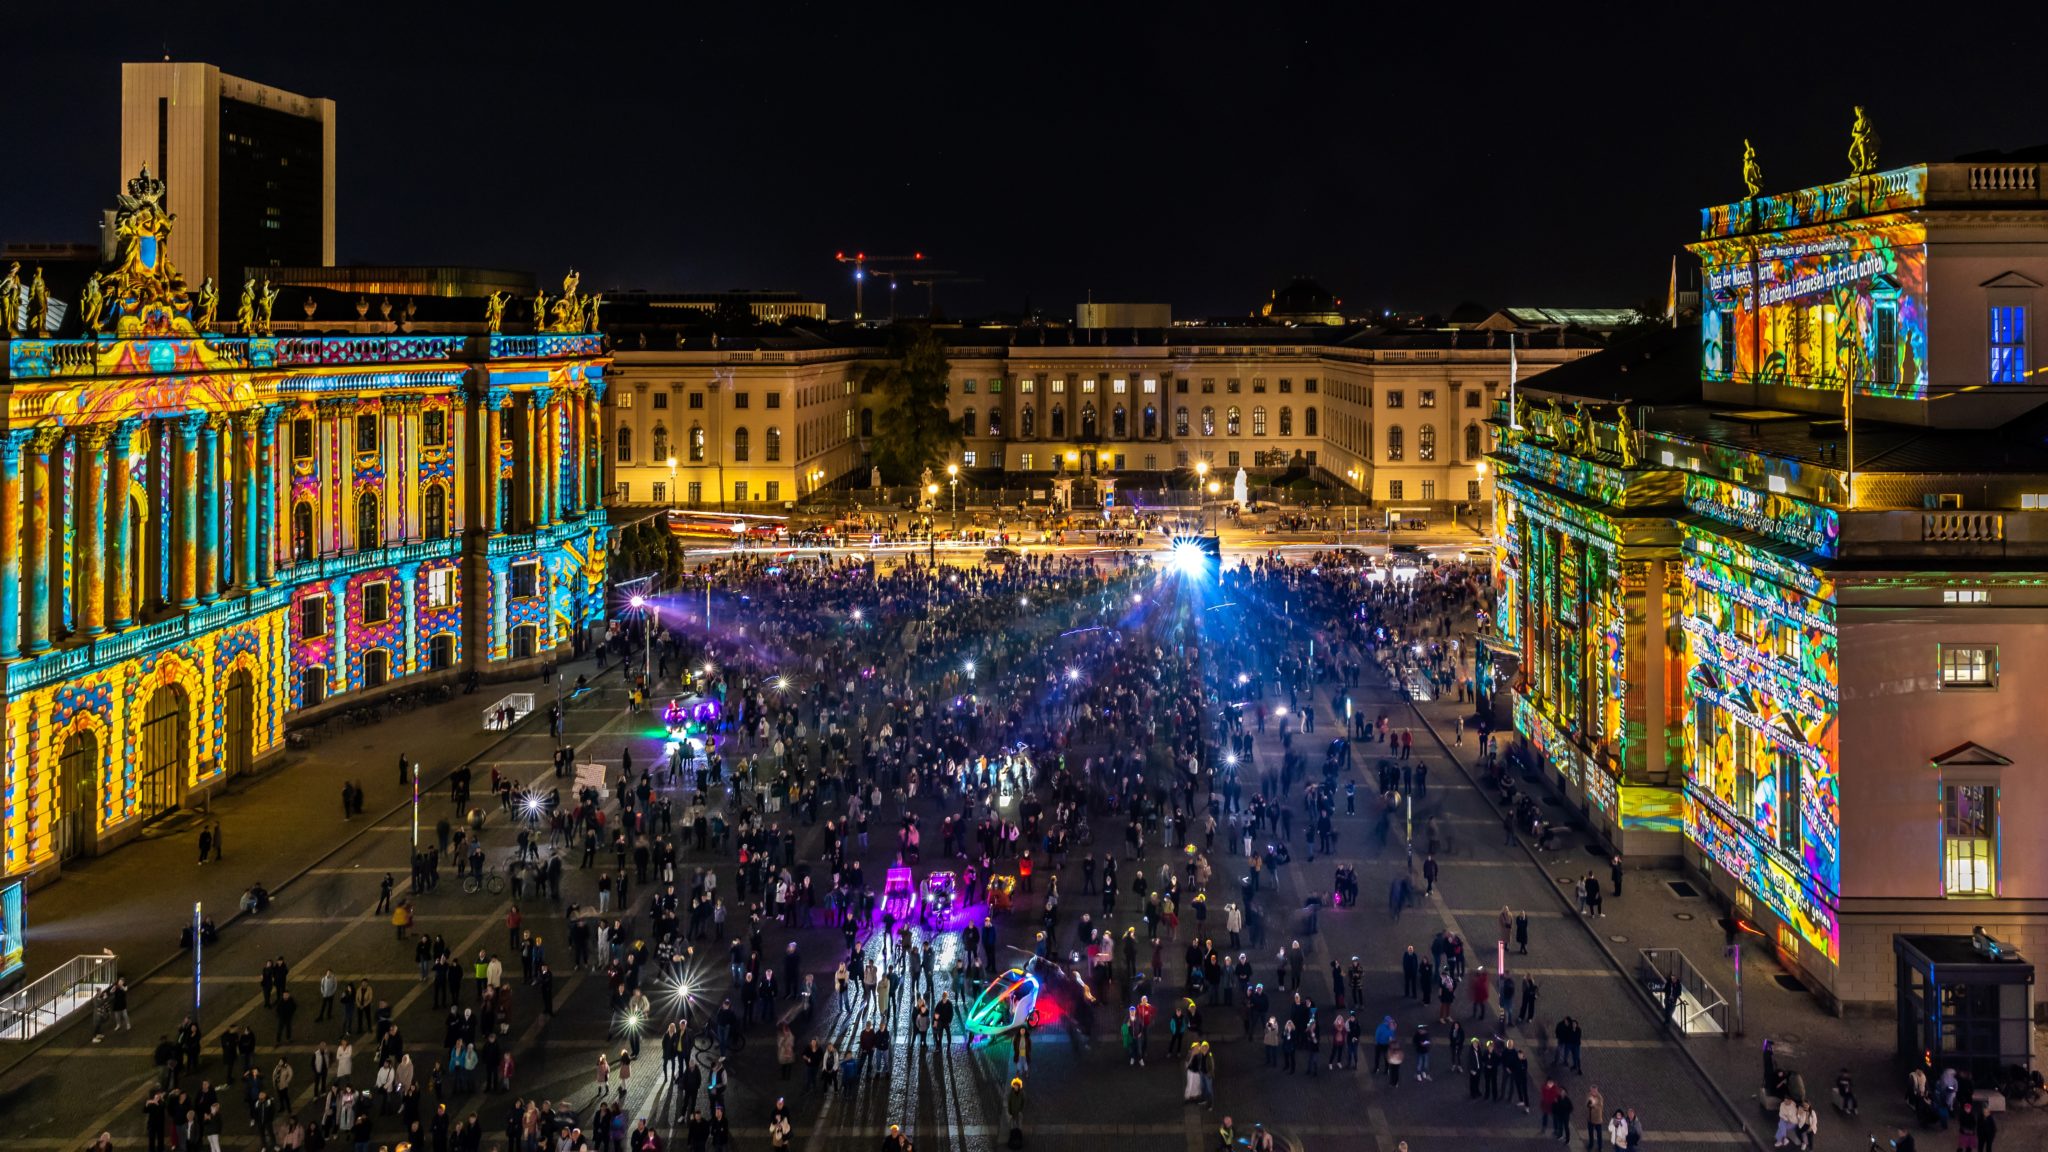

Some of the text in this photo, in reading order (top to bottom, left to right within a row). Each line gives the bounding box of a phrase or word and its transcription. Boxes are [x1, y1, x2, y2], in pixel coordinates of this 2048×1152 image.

[1791, 273, 1825, 297] Lebewesen
[1826, 266, 1837, 287] der
[1859, 251, 1884, 279] achten
[1596, 587, 1605, 737] Umweltschutz
[1799, 676, 1821, 695] gesund
[1812, 815, 1837, 863] Bildung
